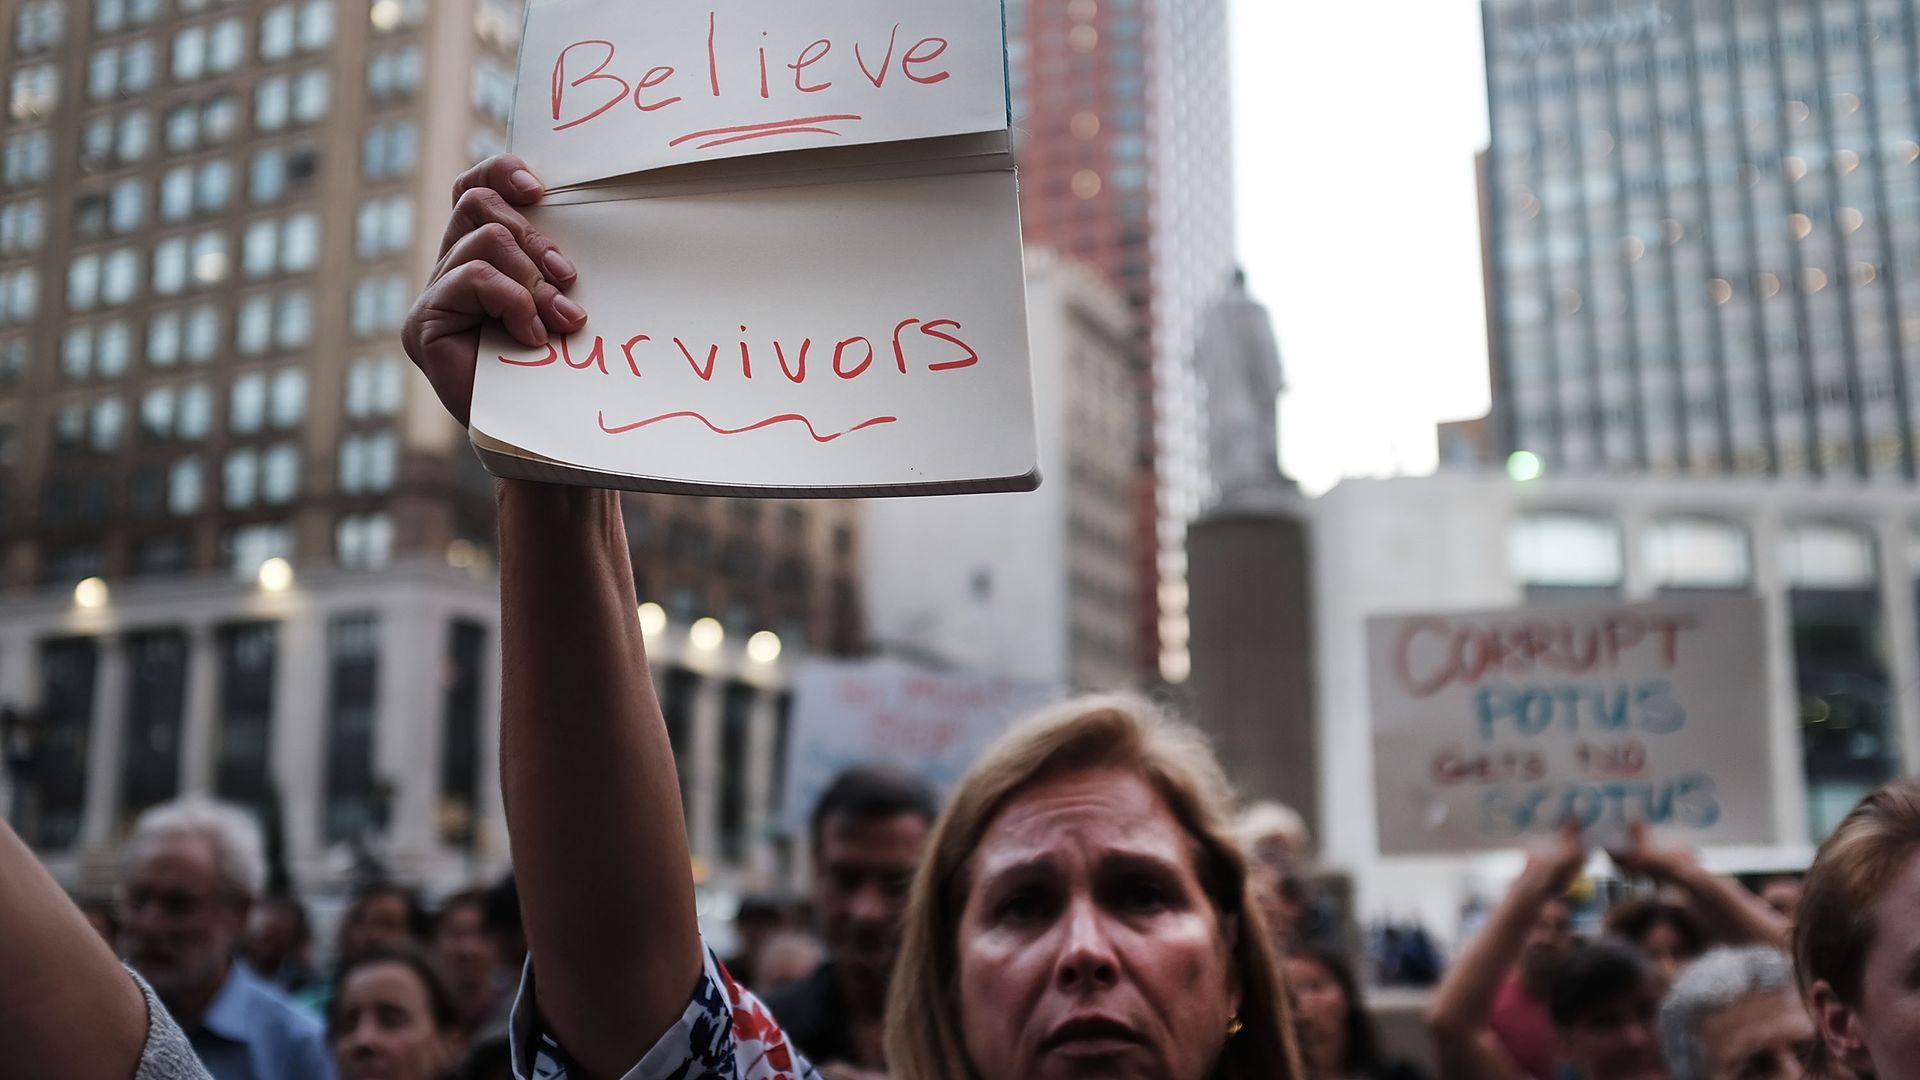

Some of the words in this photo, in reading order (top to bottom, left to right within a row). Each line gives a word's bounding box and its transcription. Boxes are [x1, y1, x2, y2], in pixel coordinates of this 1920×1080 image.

[551, 11, 950, 131] Believe
[1396, 610, 1696, 697] CORRUPT
[1476, 678, 1686, 739] POTUS
[1480, 772, 1721, 832] SCOTUS
